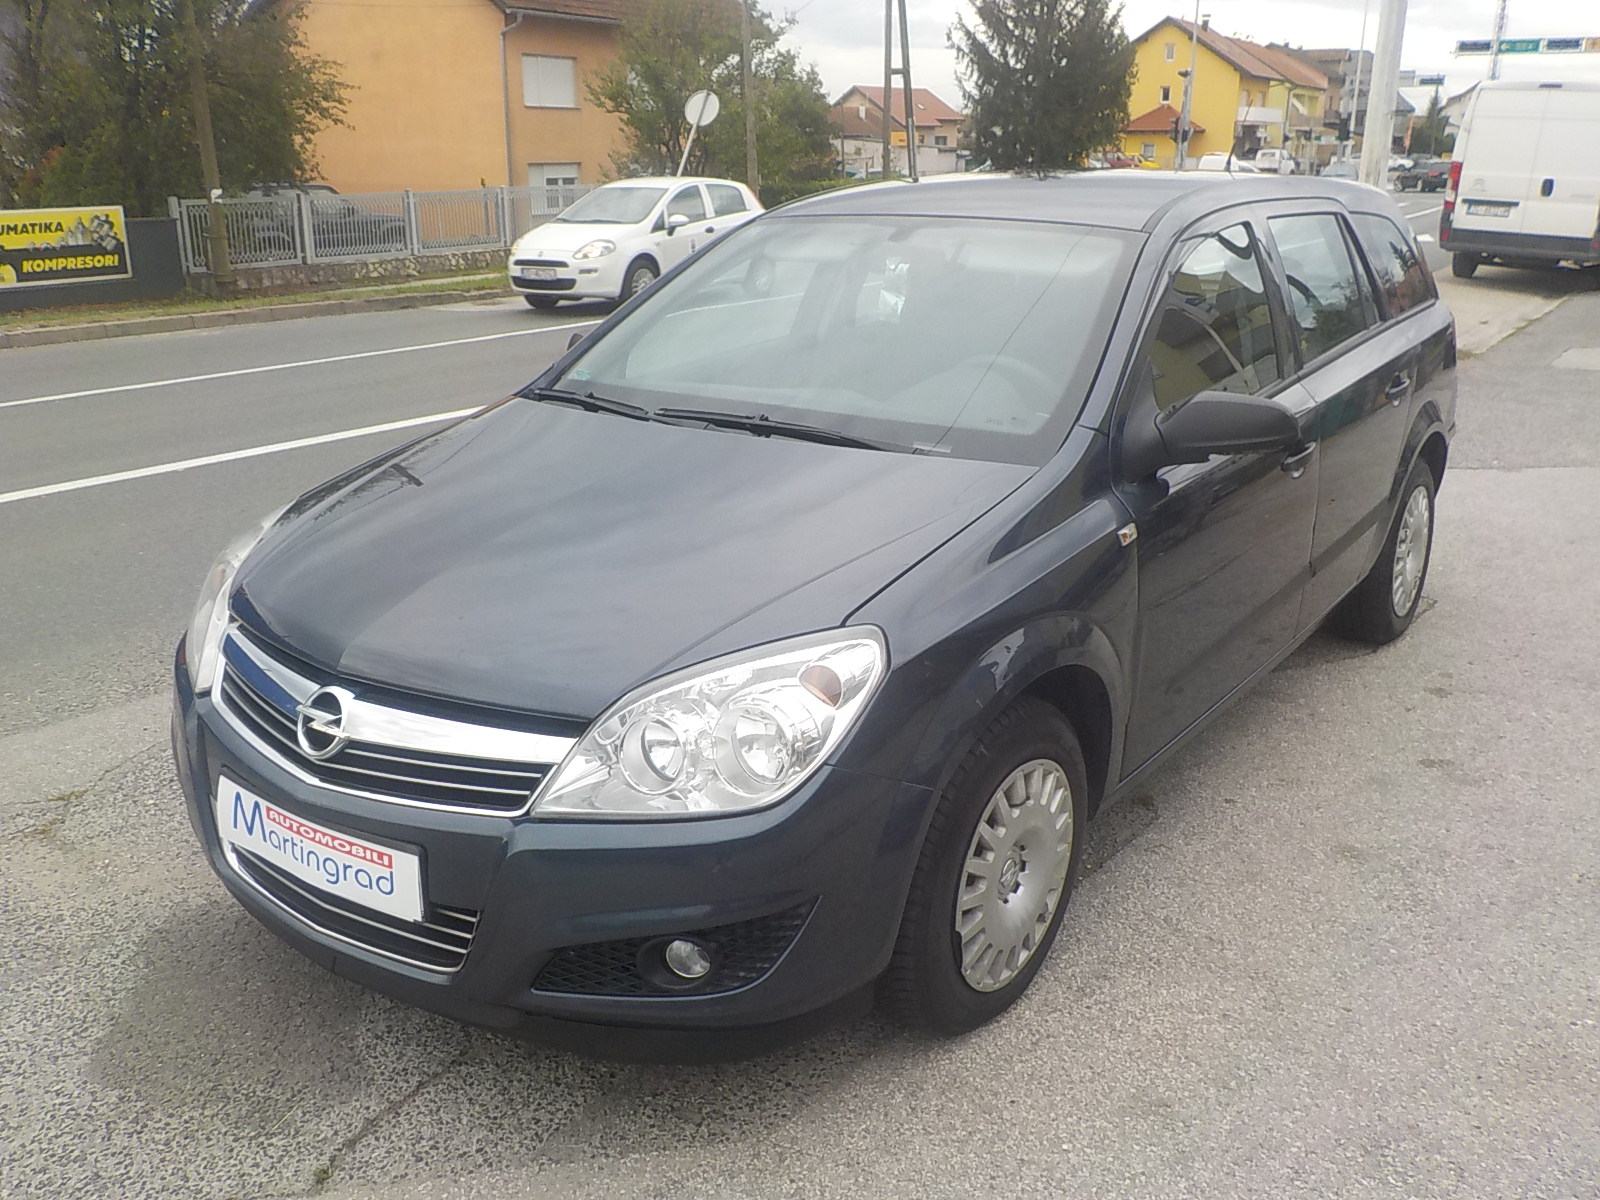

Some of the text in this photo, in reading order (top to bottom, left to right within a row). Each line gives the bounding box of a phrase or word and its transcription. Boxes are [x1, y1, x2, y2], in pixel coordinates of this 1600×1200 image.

[22, 254, 119, 273] KOMPRESORI
[233, 791, 394, 896] Martingrad
[268, 809, 390, 867] AUTOMOBILI
